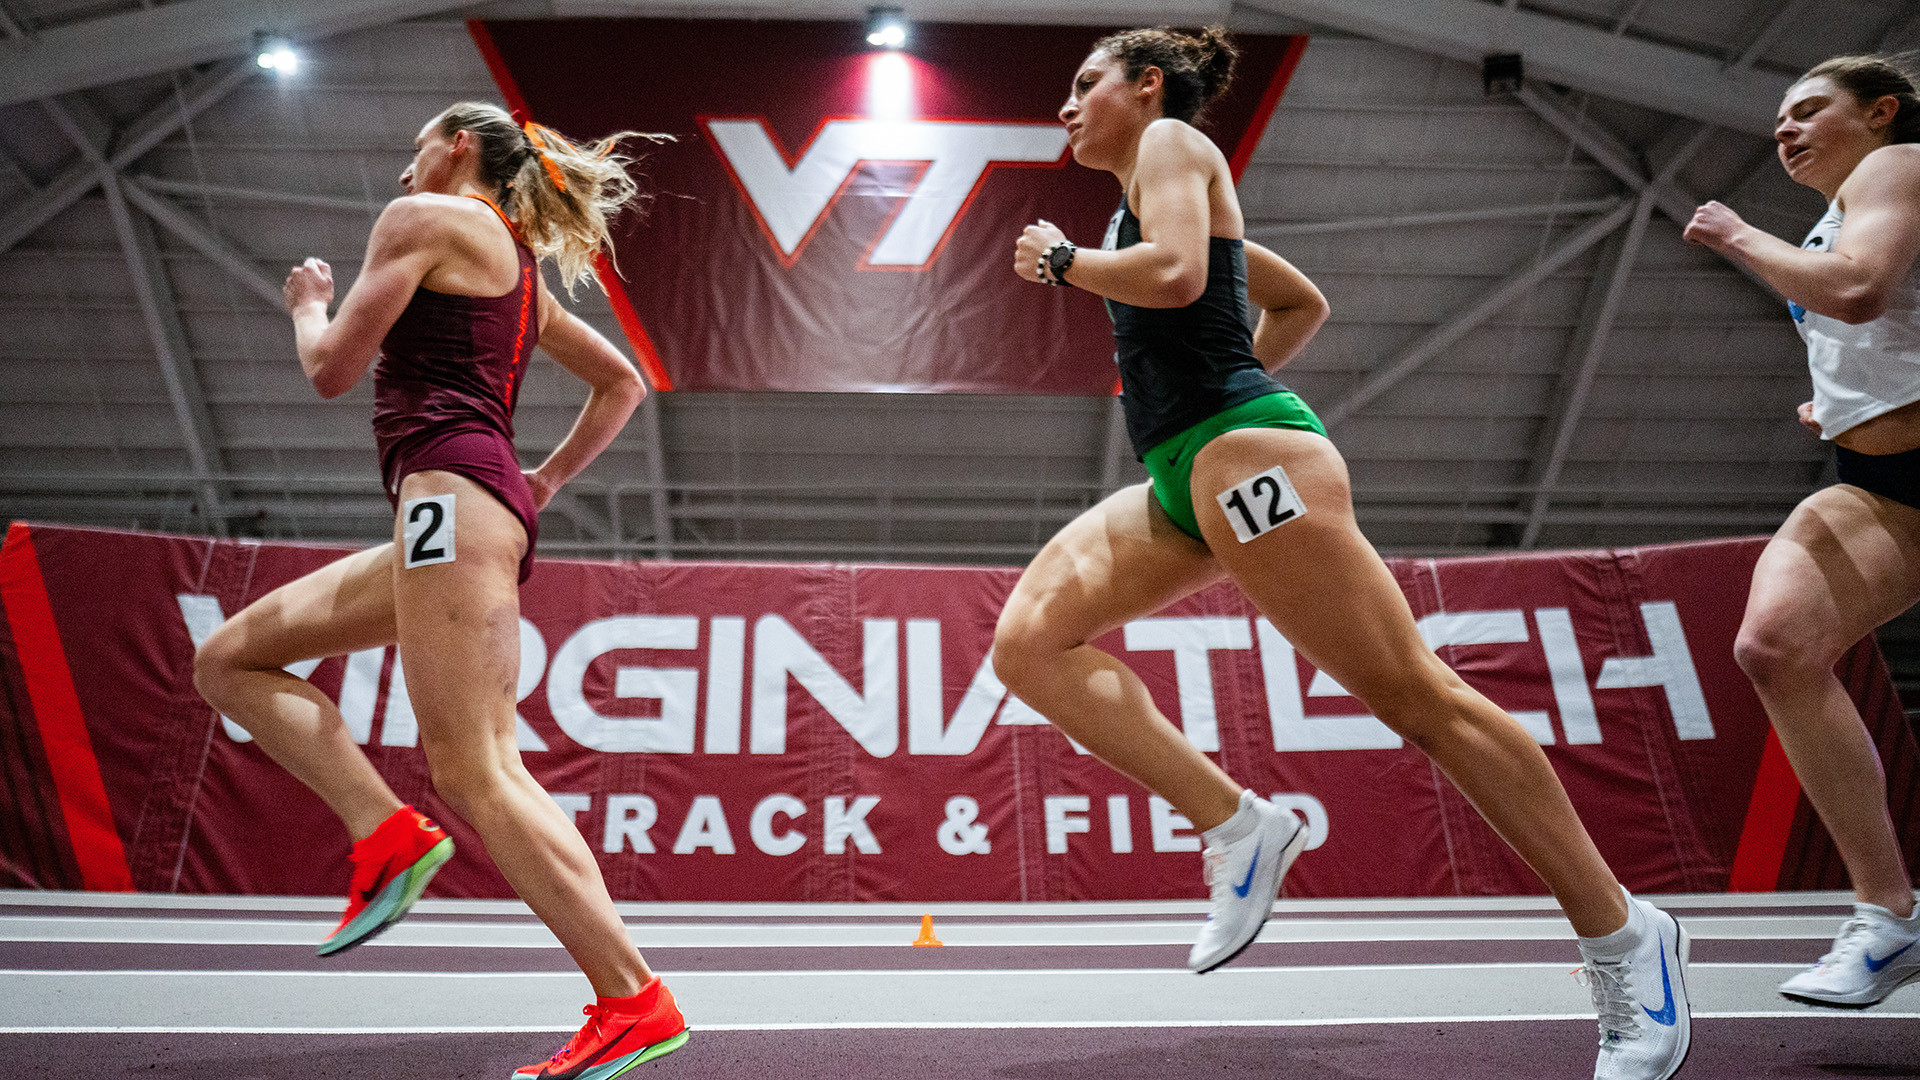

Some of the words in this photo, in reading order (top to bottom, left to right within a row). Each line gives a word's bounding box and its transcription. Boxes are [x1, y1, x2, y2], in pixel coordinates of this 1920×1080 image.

[699, 115, 1074, 270] VT
[409, 502, 445, 563] 2
[1226, 476, 1296, 535] 12
[177, 594, 1092, 758] IGINI
[937, 796, 991, 855] &
[1044, 792, 1329, 854] FIED
